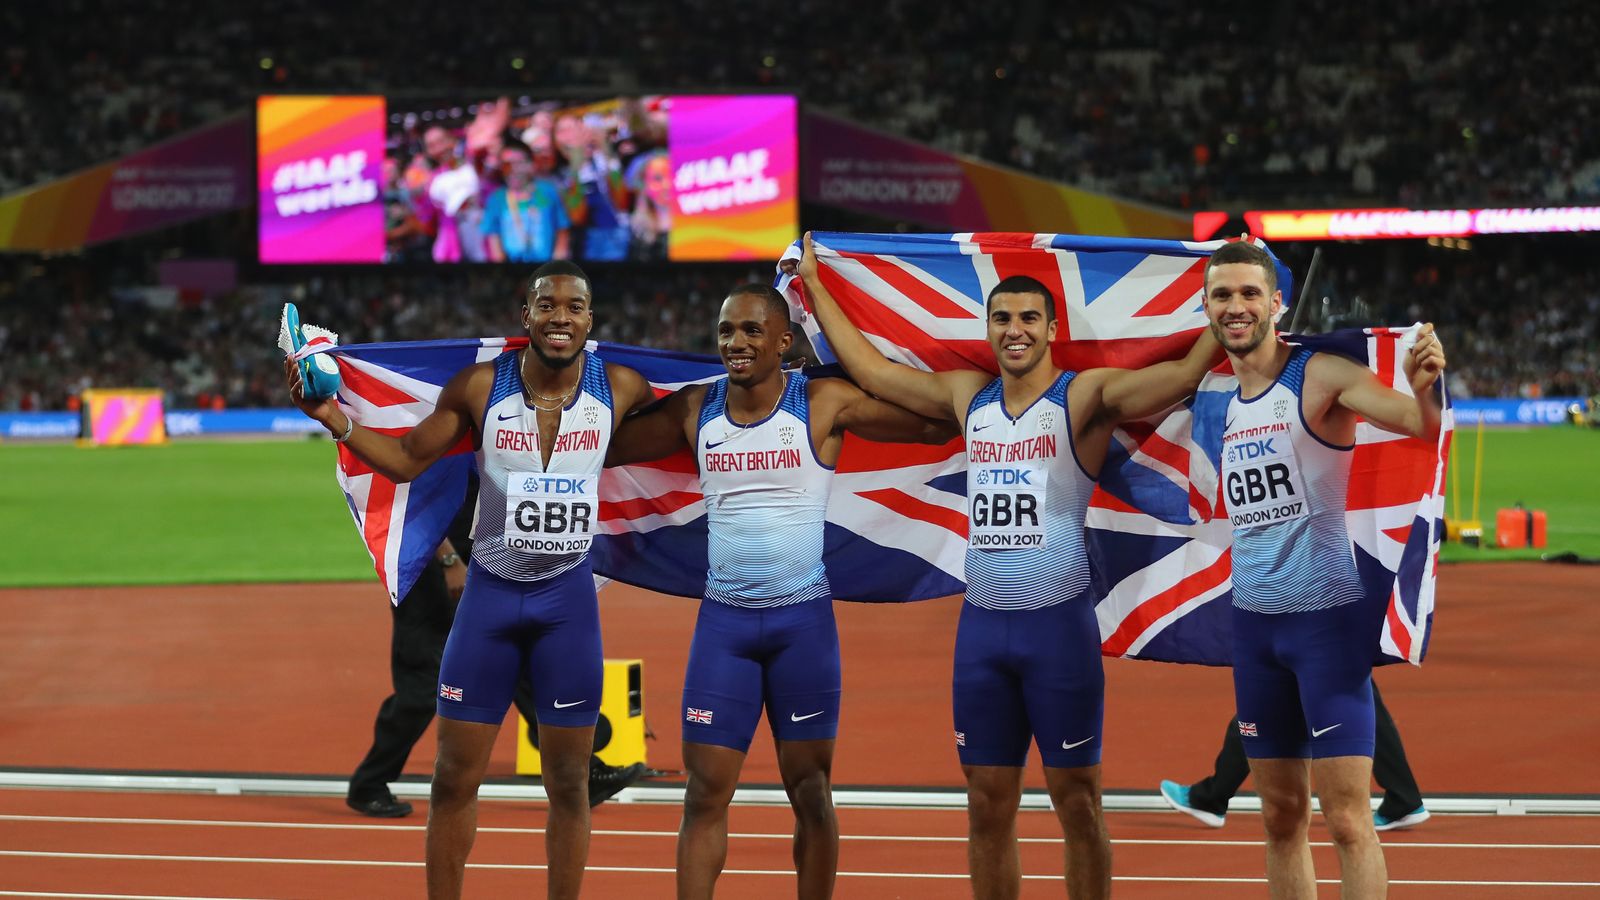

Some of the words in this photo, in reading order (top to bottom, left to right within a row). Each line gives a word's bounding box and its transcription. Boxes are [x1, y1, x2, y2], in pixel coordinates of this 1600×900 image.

[820, 177, 908, 202] LONDON
[495, 429, 535, 452] GREAT
[970, 439, 1005, 463] GREAT
[1006, 433, 1057, 463] BRITAIN
[1234, 437, 1277, 461] TDK
[705, 452, 745, 472] GREAT
[747, 448, 801, 471] BRITAIN
[538, 477, 586, 494] TDK
[990, 469, 1032, 485] TDK
[1227, 462, 1295, 507] GBR
[514, 500, 591, 534] GBR
[972, 493, 1039, 527] GBR
[1231, 510, 1271, 527] LONDON
[1272, 502, 1303, 519] 2017
[508, 538, 565, 552] LONDON
[566, 539, 590, 550] 2017
[1013, 534, 1044, 546] 2017
